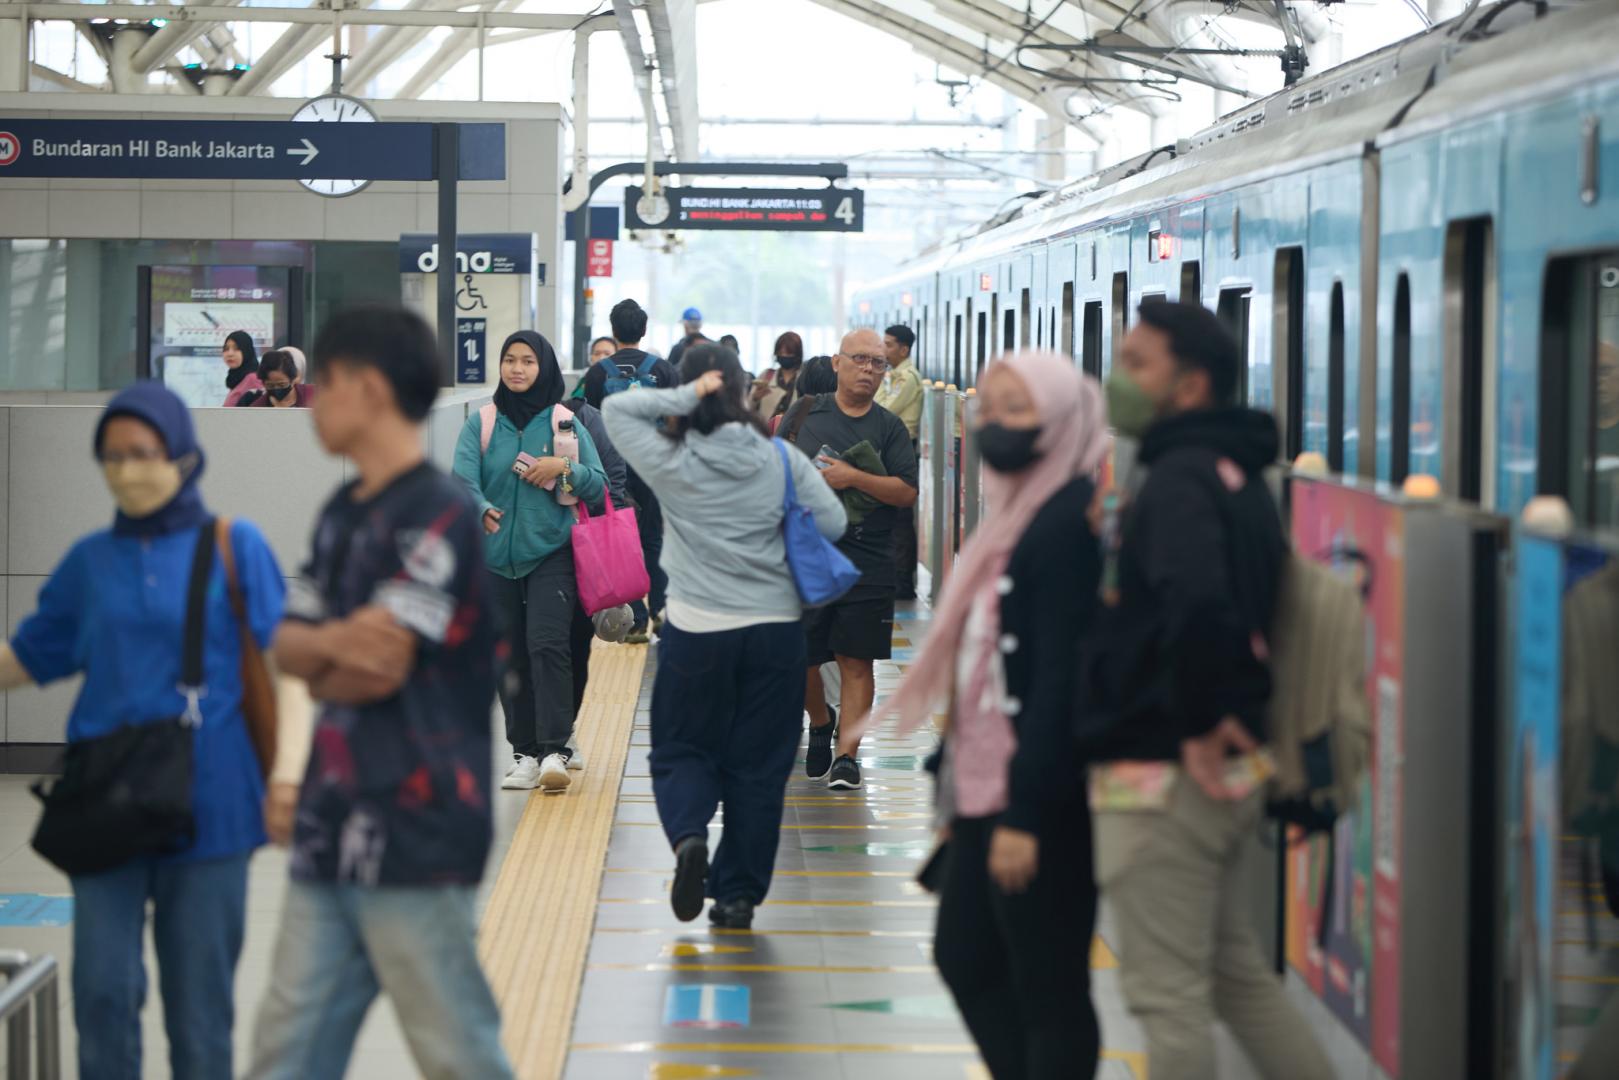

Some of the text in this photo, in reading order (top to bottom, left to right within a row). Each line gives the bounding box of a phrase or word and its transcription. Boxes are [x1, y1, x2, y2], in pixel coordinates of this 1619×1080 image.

[32, 138, 123, 157] Bundaran
[129, 140, 149, 157] HI
[155, 140, 203, 158] Bank
[206, 140, 275, 159] Jakarta
[834, 197, 856, 225] 4
[417, 243, 492, 272] dna
